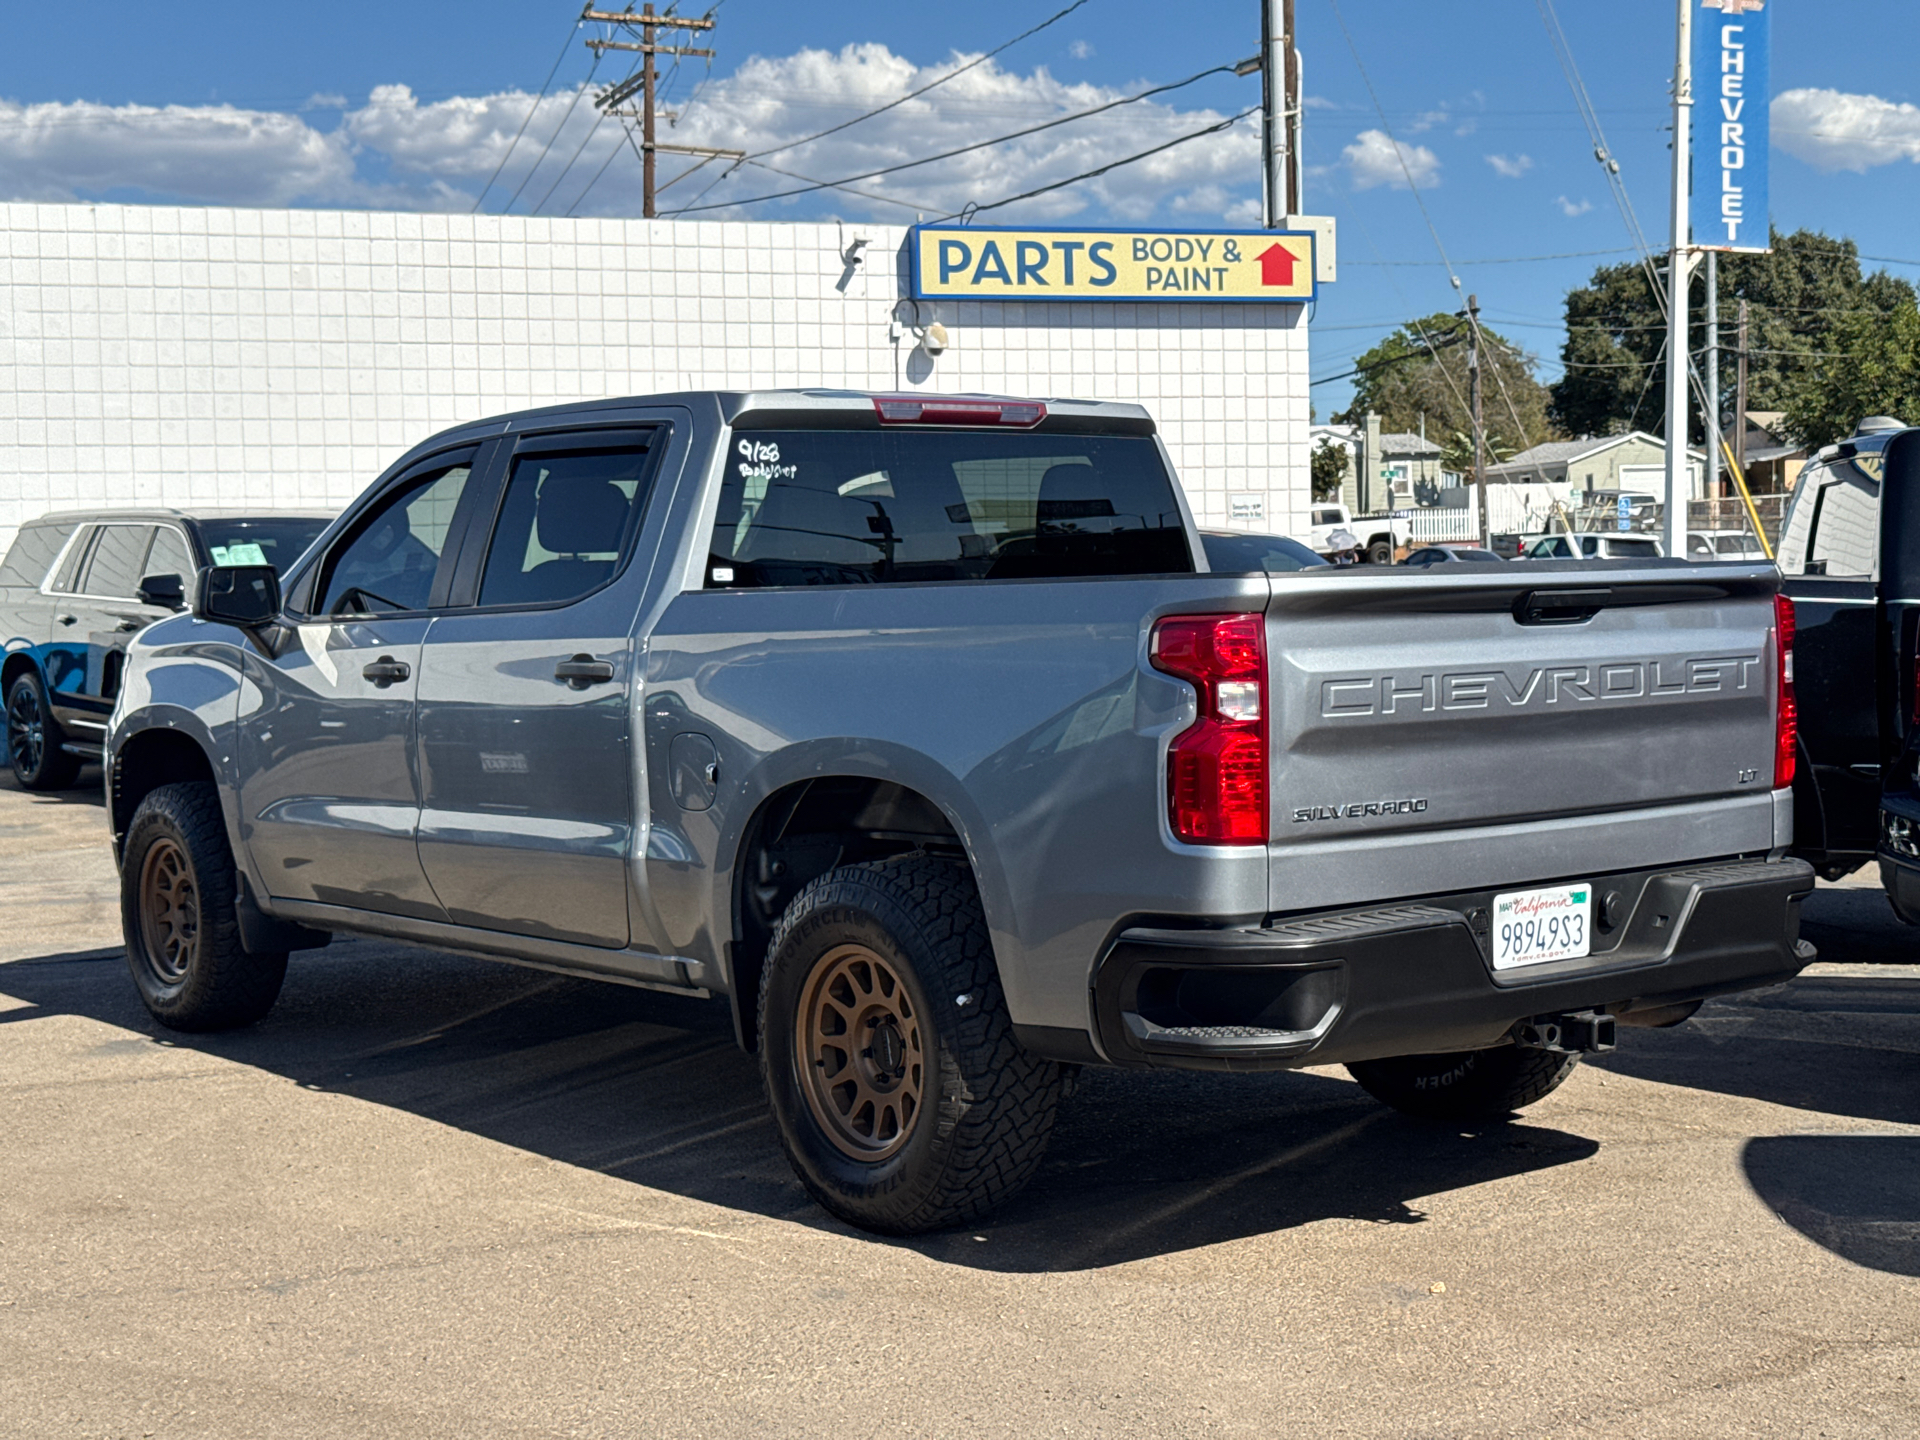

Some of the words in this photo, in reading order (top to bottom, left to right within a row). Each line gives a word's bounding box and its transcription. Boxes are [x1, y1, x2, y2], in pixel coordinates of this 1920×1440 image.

[1721, 25, 1745, 241] CHEVROLET
[938, 239, 1117, 287] PARTS
[1132, 238, 1215, 263] BODY
[1222, 238, 1242, 264] &
[1146, 266, 1229, 291] PAINT
[738, 439, 780, 463] 9/28
[1320, 655, 1760, 718] CHEVROLET
[1738, 768, 1759, 784] LT
[1292, 798, 1428, 823] SILVERADO
[1499, 901, 1513, 913] MAR
[1514, 895, 1573, 917] California
[1501, 913, 1584, 959] 98949S3
[1516, 950, 1565, 962] dmv.ca.gov
